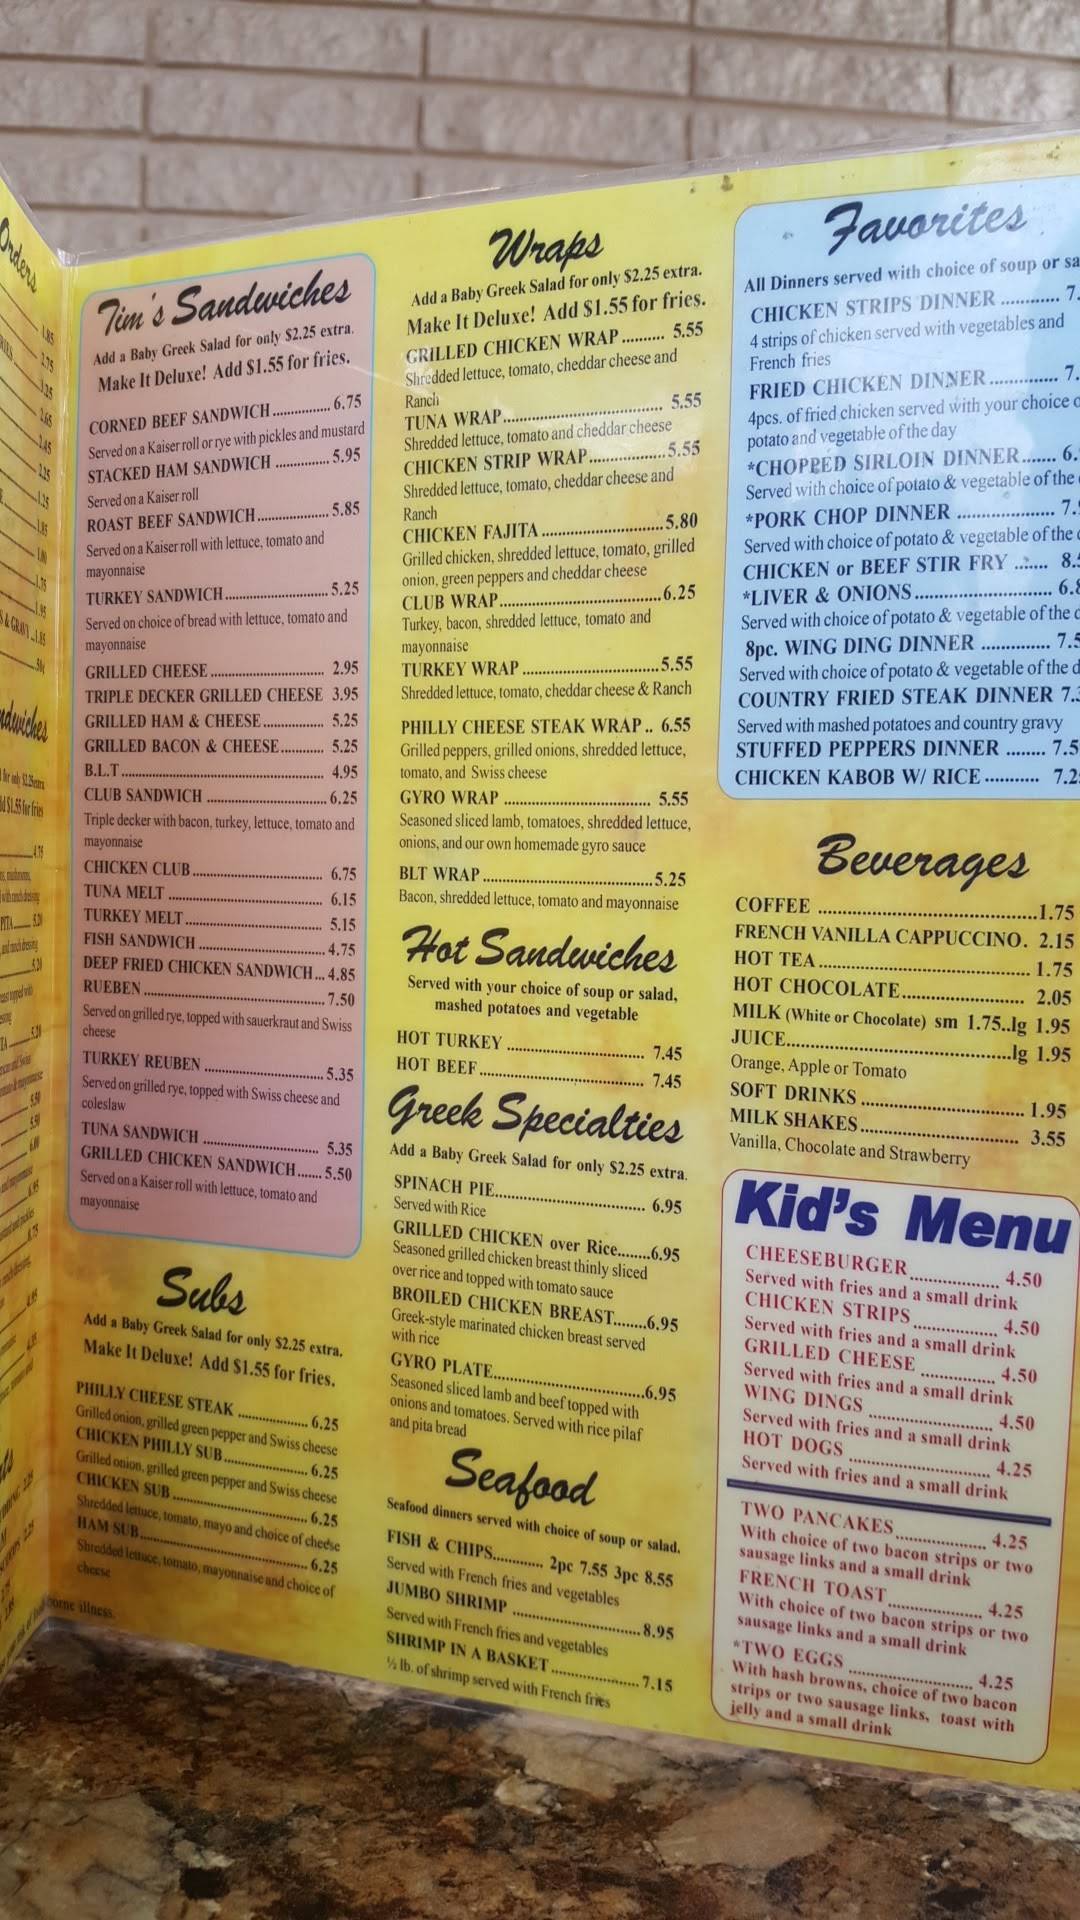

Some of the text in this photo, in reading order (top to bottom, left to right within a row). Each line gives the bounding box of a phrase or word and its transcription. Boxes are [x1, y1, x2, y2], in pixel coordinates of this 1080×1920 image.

[824, 201, 1027, 255] Favorites
[488, 228, 604, 272] Wraps
[743, 257, 1061, 293] All Dinners served with choice of soup or
[98, 270, 352, 337] Tim's Sandwiches
[92, 324, 354, 366] Add a Baby Greek Salad for only $2.25 extra.
[405, 320, 704, 363] GRILLED CHICKEN WRAP 5.55
[98, 349, 351, 393] Make It Deluxe! Add $1.55 for fries.
[405, 347, 678, 386] Shredded lettuce, tomato, cheddar cheese and
[405, 391, 440, 409] Ranch
[87, 446, 361, 484] STACKED HAM SANDWICH 5.95
[84, 686, 359, 704] TRIPLE DECKER GRILLED CHEESE 3.95
[737, 686, 1053, 709] COUNTRY FRIED STEAK DINNER
[401, 716, 692, 735] PHILLY CHEESE STEAK WRAP 6.55
[736, 714, 1064, 736] Served with mashed potatoes and country gravy
[735, 739, 999, 759] STUFFED PEPPERS DINNER
[83, 787, 358, 805] CLUB SANDWICH 6.25
[399, 789, 689, 807] GYRO WRAP 5.55
[734, 768, 981, 786] CHICKEN KABOB W/ RICE
[816, 833, 1030, 892] Beverages
[83, 883, 357, 907] TUNA MELT 6.15
[735, 896, 811, 914] COFFEE
[401, 925, 678, 973] Hot Sandwiches
[83, 978, 356, 1007] RUEBEN 7.50
[407, 974, 678, 1003] Served with your choice of soup or salad,
[396, 1029, 683, 1062] HOT TURKEY 7.45
[730, 1053, 908, 1079] Orange, Apple or Tomato
[387, 1084, 683, 1143] Greek Specialties
[729, 1081, 1068, 1120] SOFT DRINKS 1.95
[81, 1121, 353, 1157] TUNA SANDWICH 5.35
[730, 1107, 1066, 1148] MILK SHAKES 3.55
[735, 1179, 1072, 1254] Kid's Menu
[745, 1244, 1043, 1288] CHEESEBURGER 4.50
[156, 1266, 247, 1315] Subs
[745, 1268, 1019, 1311] Served with fries and a small drink
[744, 1291, 1041, 1337] CHICKEN STRIPS 4.50
[75, 1380, 340, 1432] PHILLY CHEESE STEAK 6.25
[743, 1429, 1033, 1479] HOT DOGS 4.25
[75, 1471, 339, 1528] CHICKEN SUB 6.25
[445, 1448, 598, 1510] Seafood
[741, 1501, 1028, 1551] TWO PANCAKES 4.25
[385, 1580, 675, 1641] JUMBO SHRIMP 8.95
[739, 1569, 1024, 1620] FRENCH TOAST 4.25
[385, 1630, 674, 1693] SHRIMP IN A BASKET 7.15
